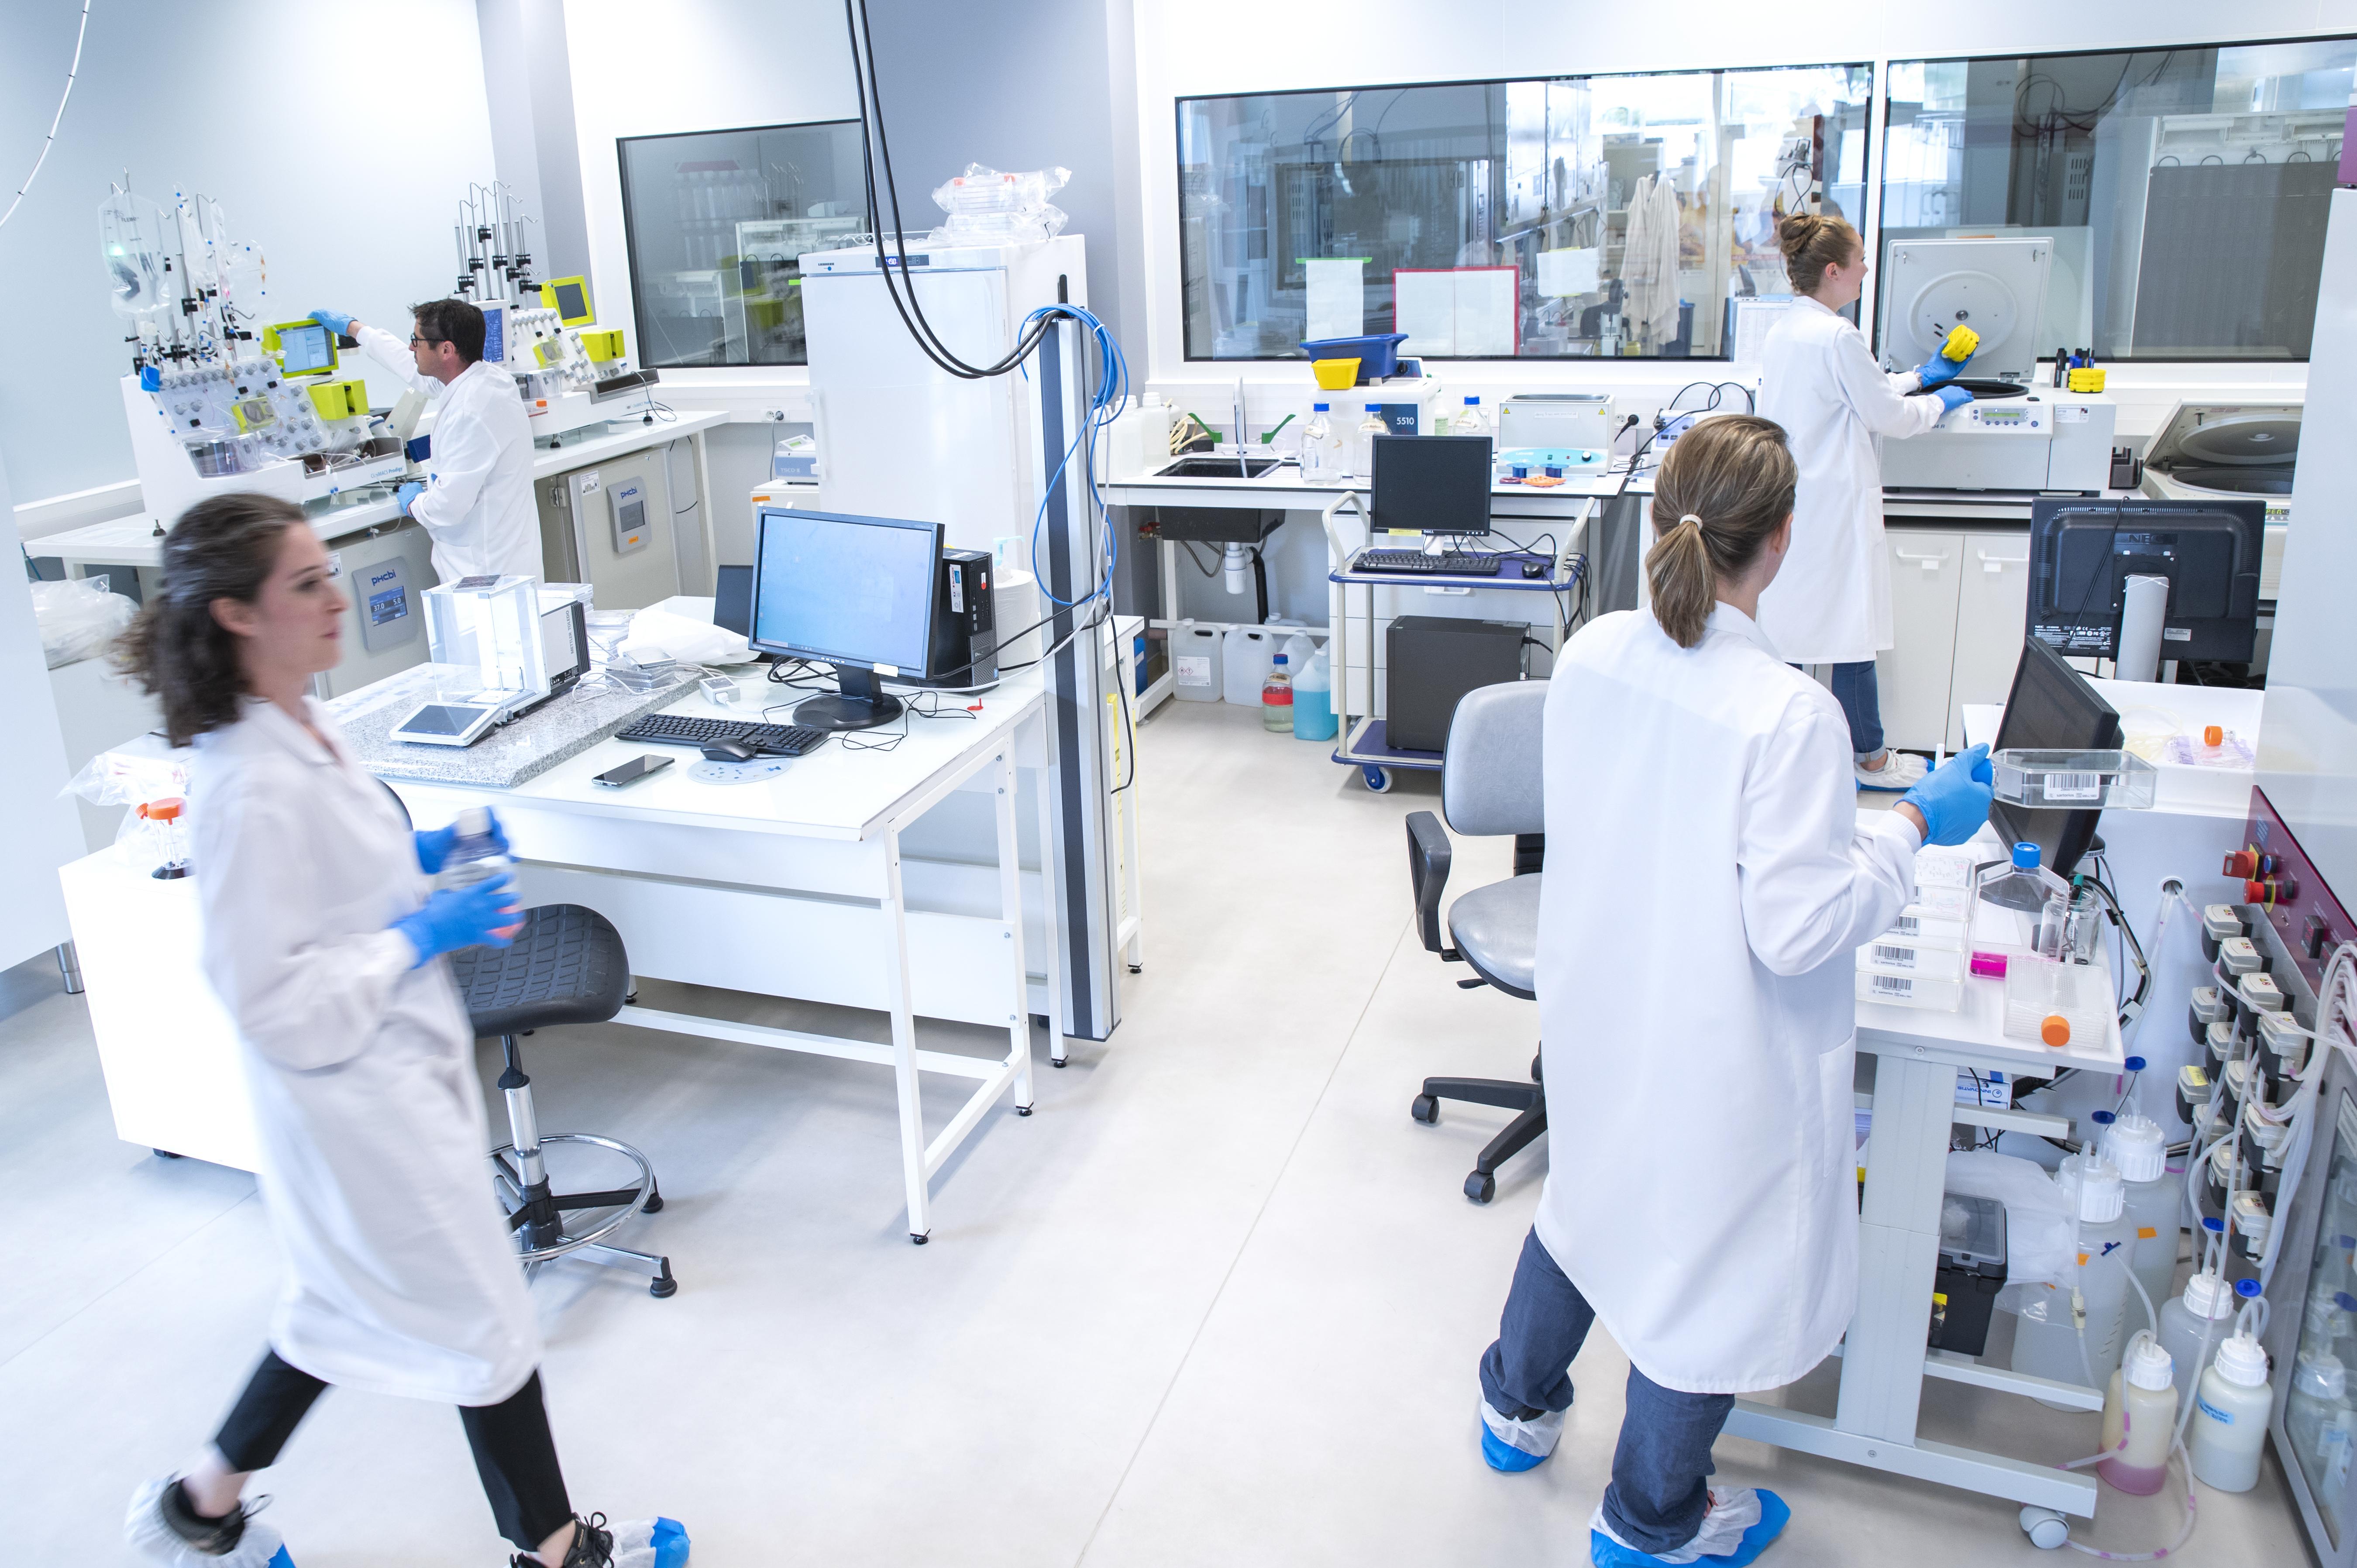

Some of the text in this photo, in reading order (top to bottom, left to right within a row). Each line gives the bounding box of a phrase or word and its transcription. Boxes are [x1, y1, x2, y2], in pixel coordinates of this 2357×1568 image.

[1397, 417, 1414, 425] 5510
[2129, 534, 2164, 544] NEC
[374, 603, 385, 612] 37.0
